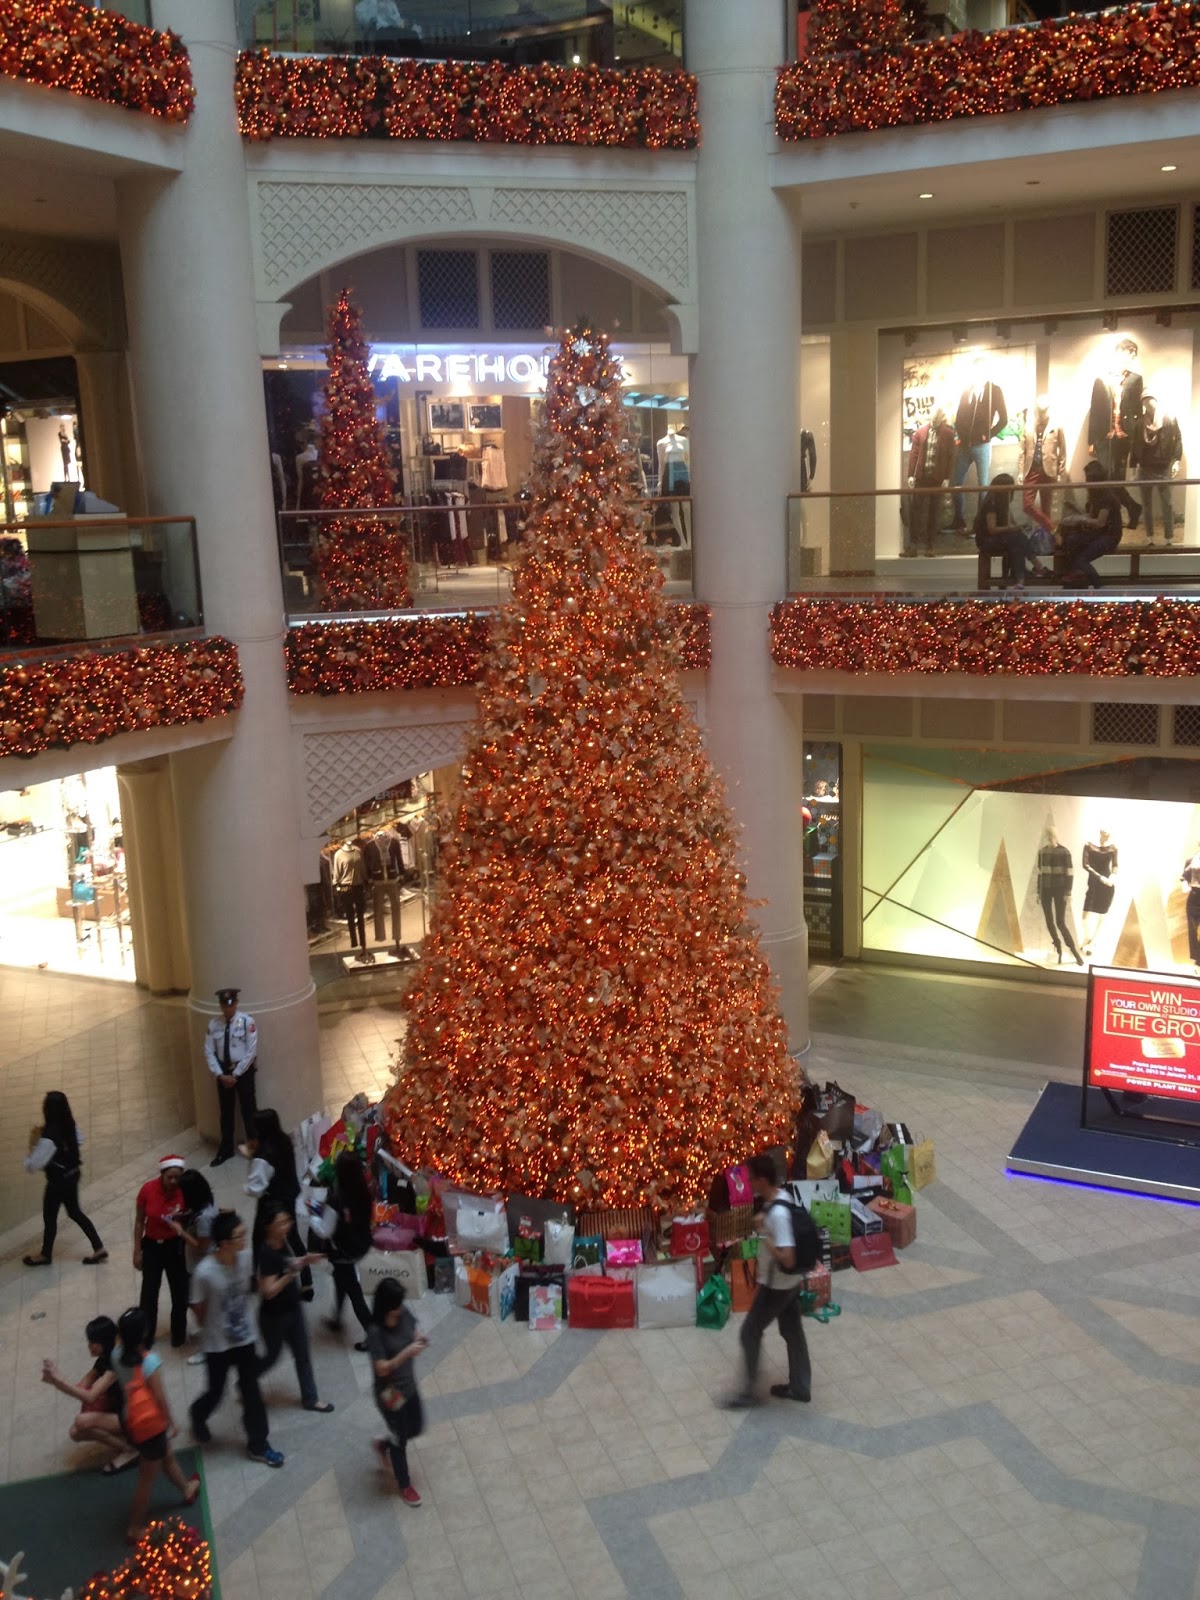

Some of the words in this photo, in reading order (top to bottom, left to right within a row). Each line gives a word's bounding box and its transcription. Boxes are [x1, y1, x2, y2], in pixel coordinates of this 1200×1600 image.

[366, 353, 550, 383] AREHO
[1150, 990, 1182, 1006] WIN
[1110, 999, 1136, 1009] YOUR
[1138, 1002, 1161, 1012] OWN
[1162, 1005, 1198, 1017] STUDIO
[1110, 1012, 1146, 1032] THE
[1109, 1063, 1135, 1071] November
[1126, 1078, 1152, 1086] POWER
[1153, 1082, 1176, 1090] PLANT
[368, 1267, 410, 1278] MANGO
